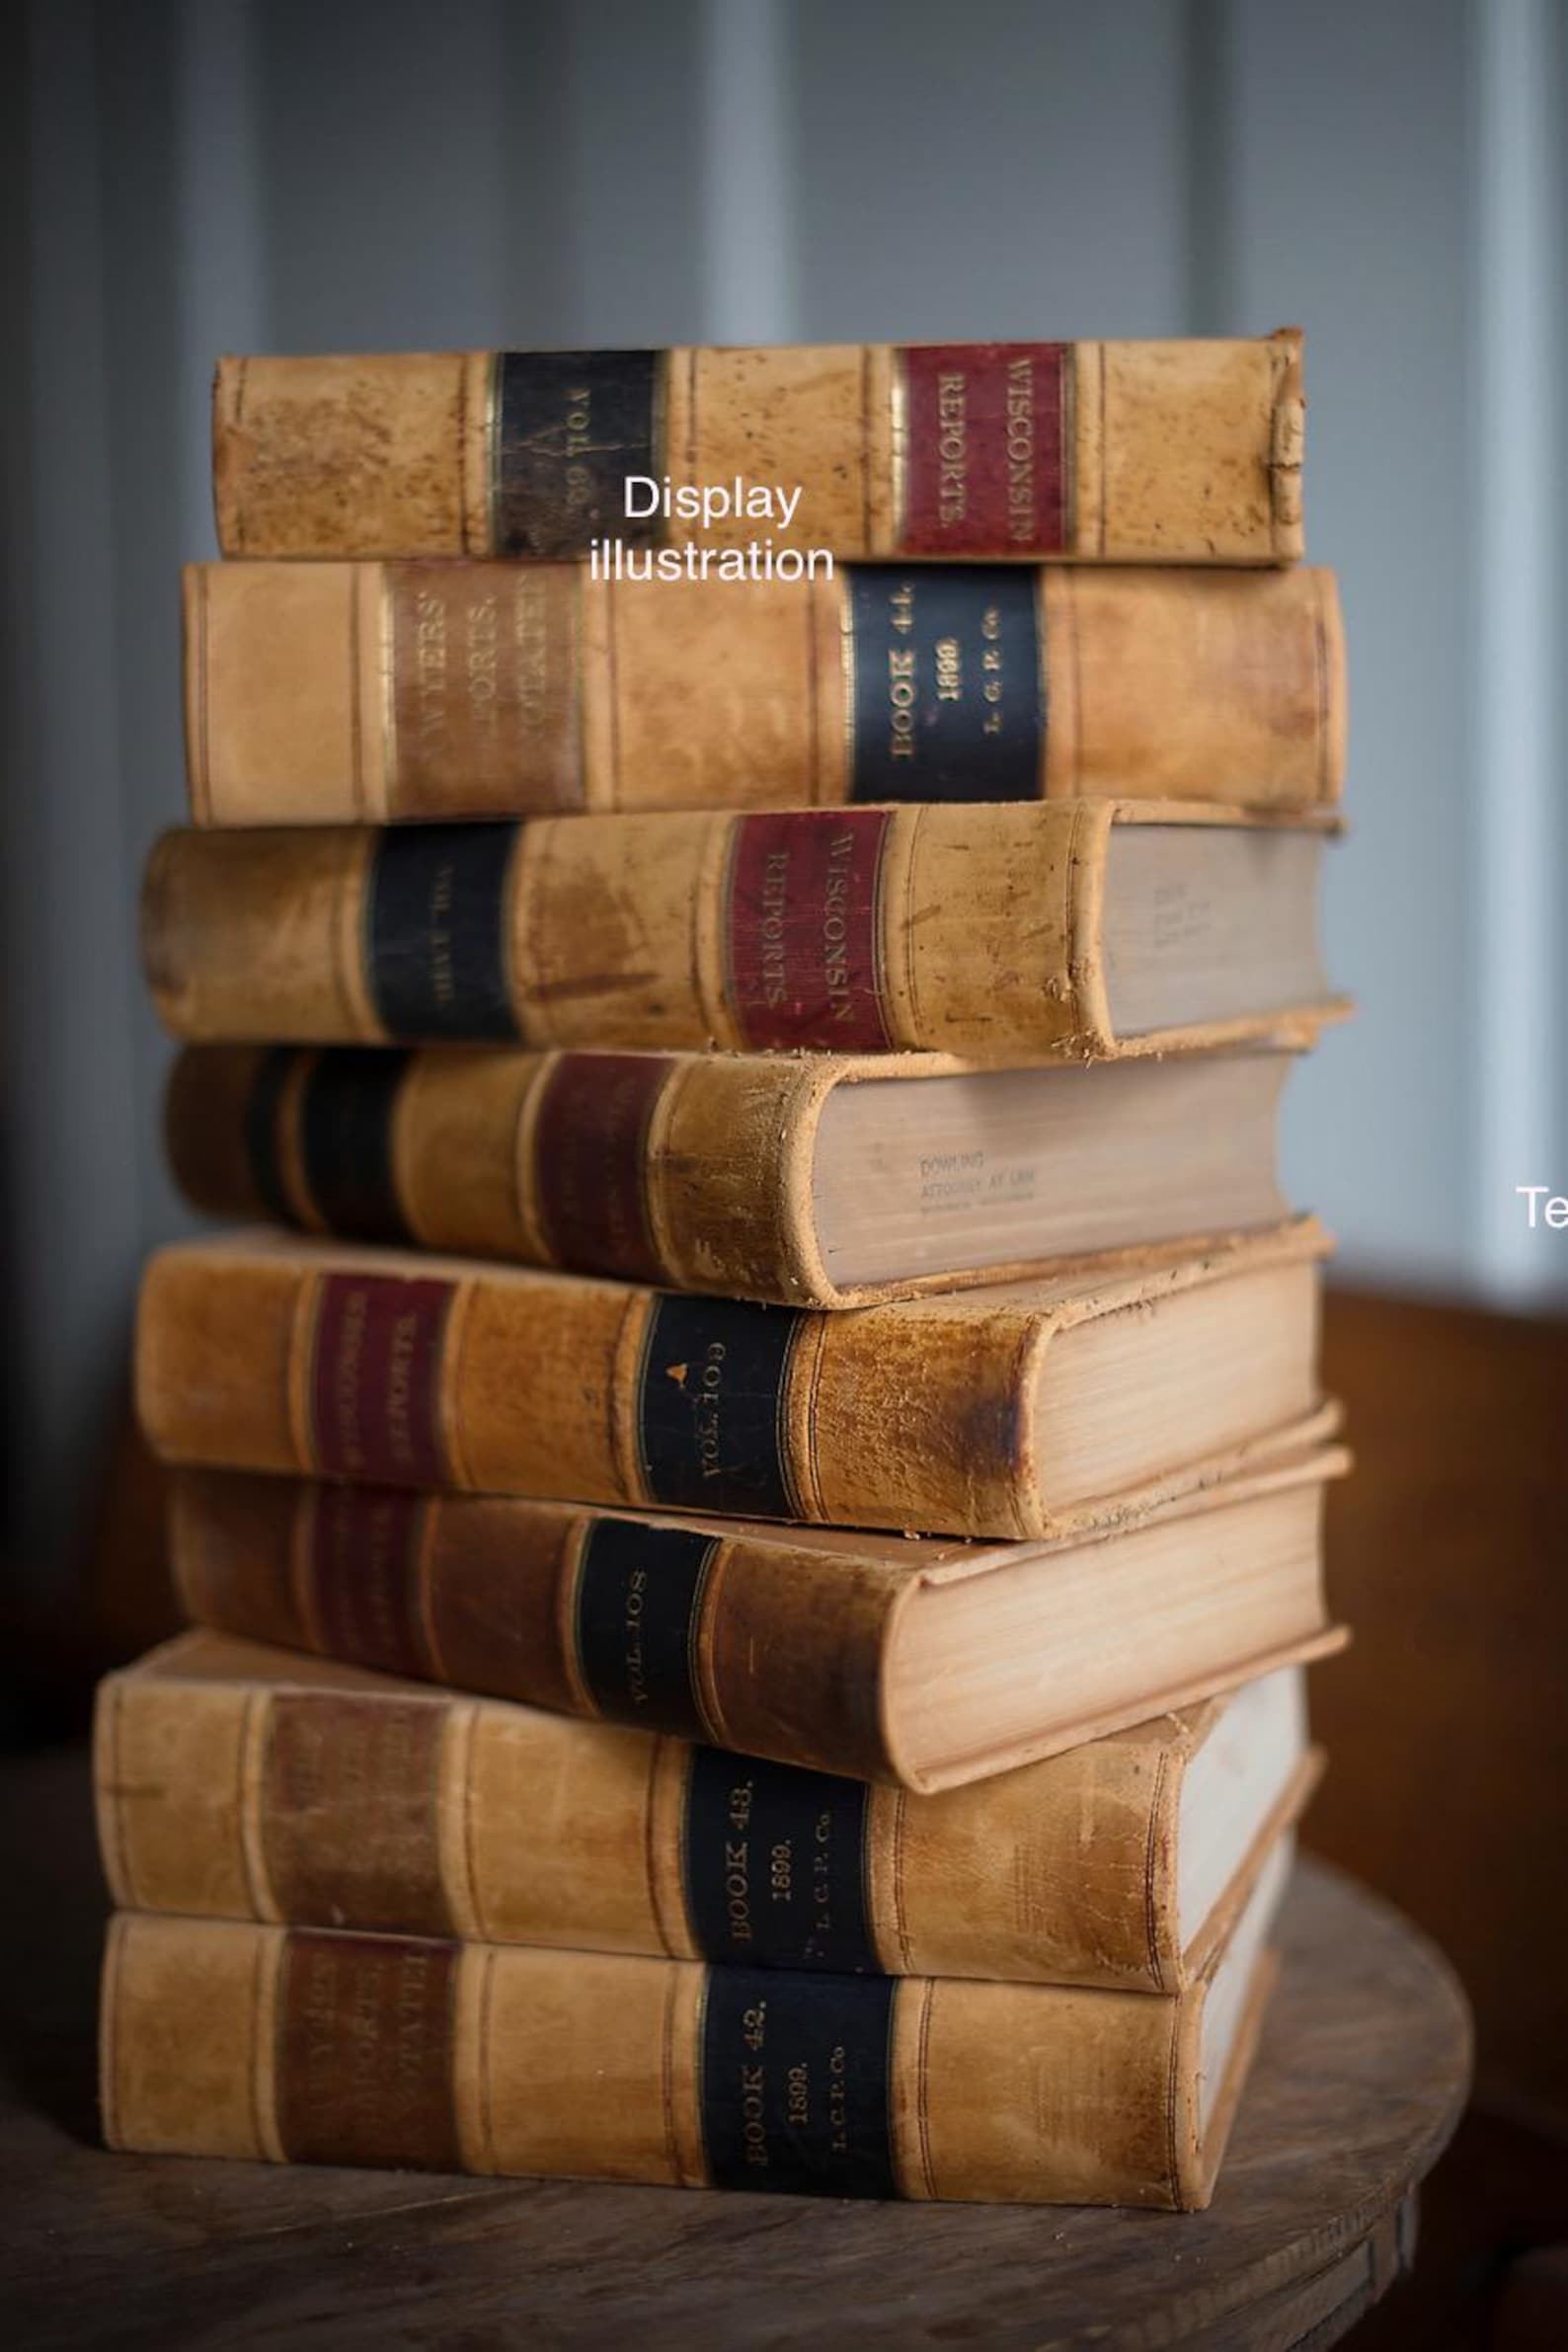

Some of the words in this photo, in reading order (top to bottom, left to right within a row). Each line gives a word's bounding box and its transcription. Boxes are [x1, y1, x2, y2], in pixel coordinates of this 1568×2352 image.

[1007, 356, 1036, 542] WISCONSIN
[889, 649, 916, 760] BOOK
[823, 832, 856, 1022] WISCONSIN
[725, 1841, 753, 1941] BOOK
[771, 1839, 792, 1902] 1899.
[743, 1999, 767, 2051] 42.
[741, 2065, 769, 2166] BOOK
[788, 2062, 809, 2125] 1899.
